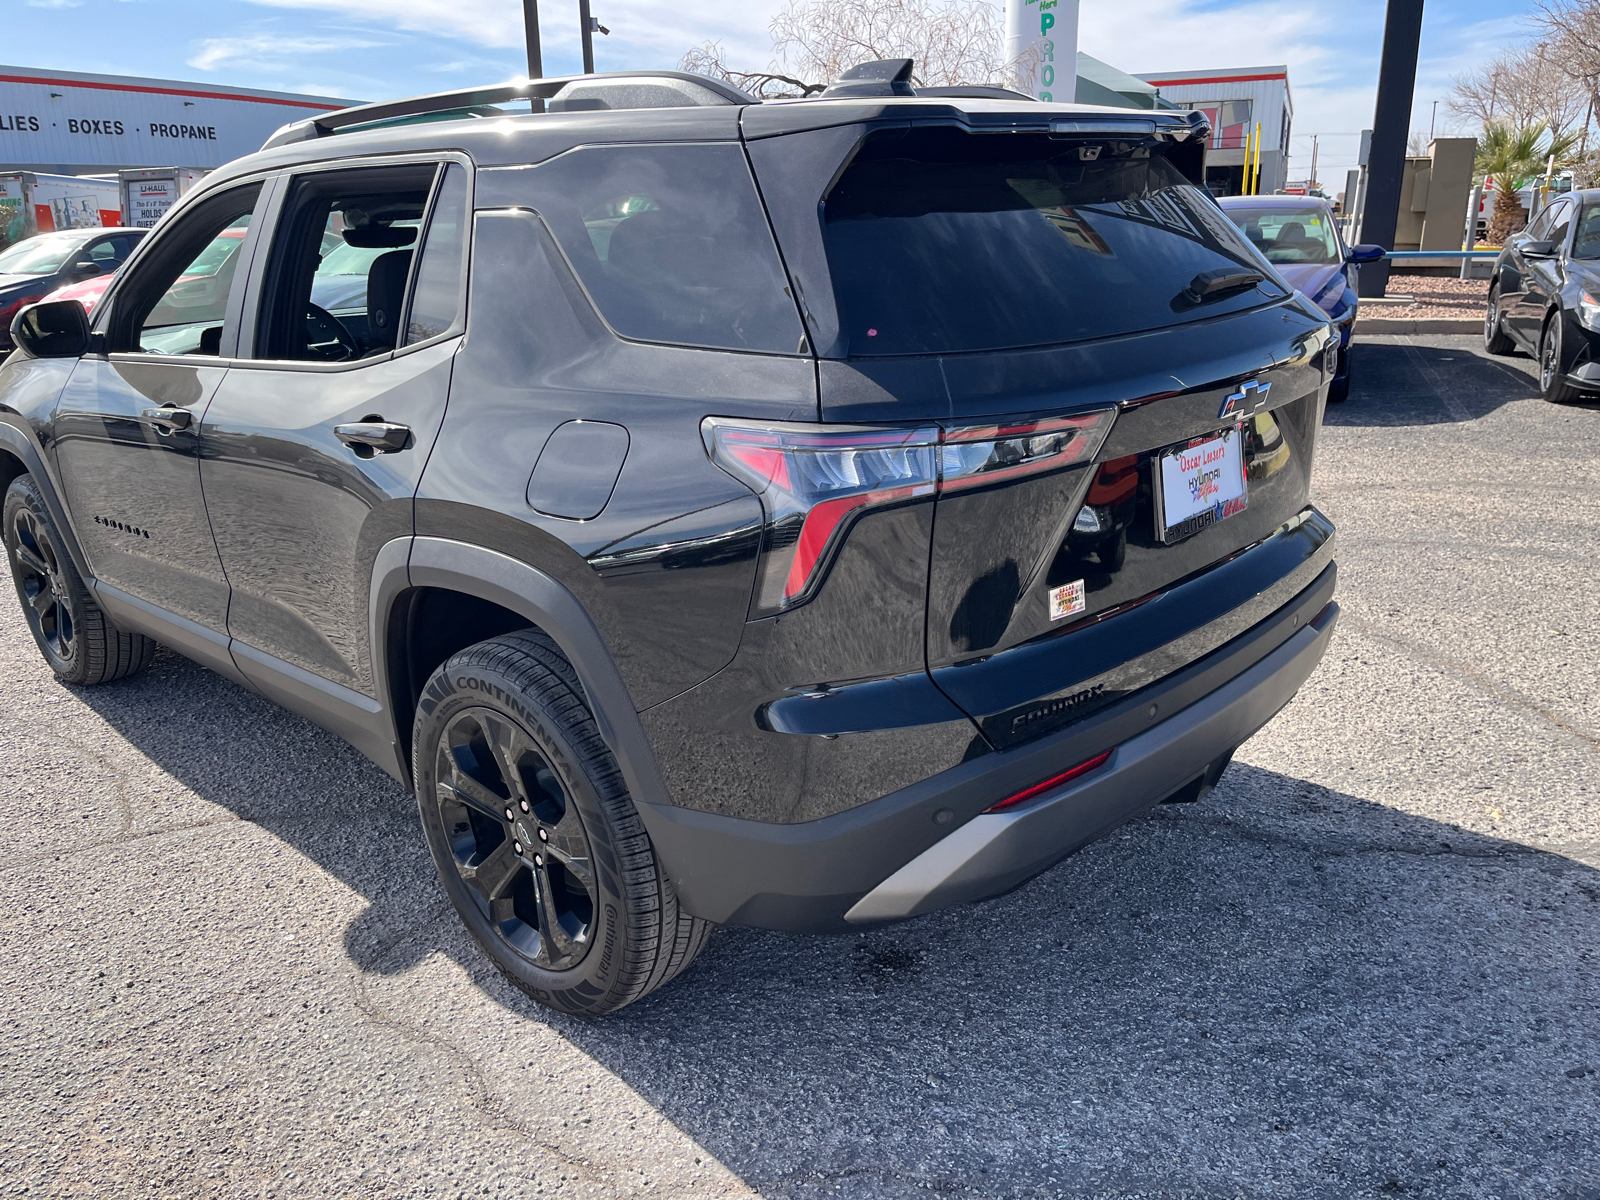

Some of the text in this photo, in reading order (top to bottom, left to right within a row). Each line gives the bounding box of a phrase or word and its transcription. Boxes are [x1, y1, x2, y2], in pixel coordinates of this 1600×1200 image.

[68, 118, 125, 135] BOXES
[150, 123, 217, 140] PROPANE
[141, 184, 167, 192] U-HAUL
[141, 209, 162, 218] HOLDS
[1180, 455, 1202, 473] Oscar
[1188, 468, 1220, 490] HYUNDAI
[456, 676, 581, 791] CONTINENTAL
